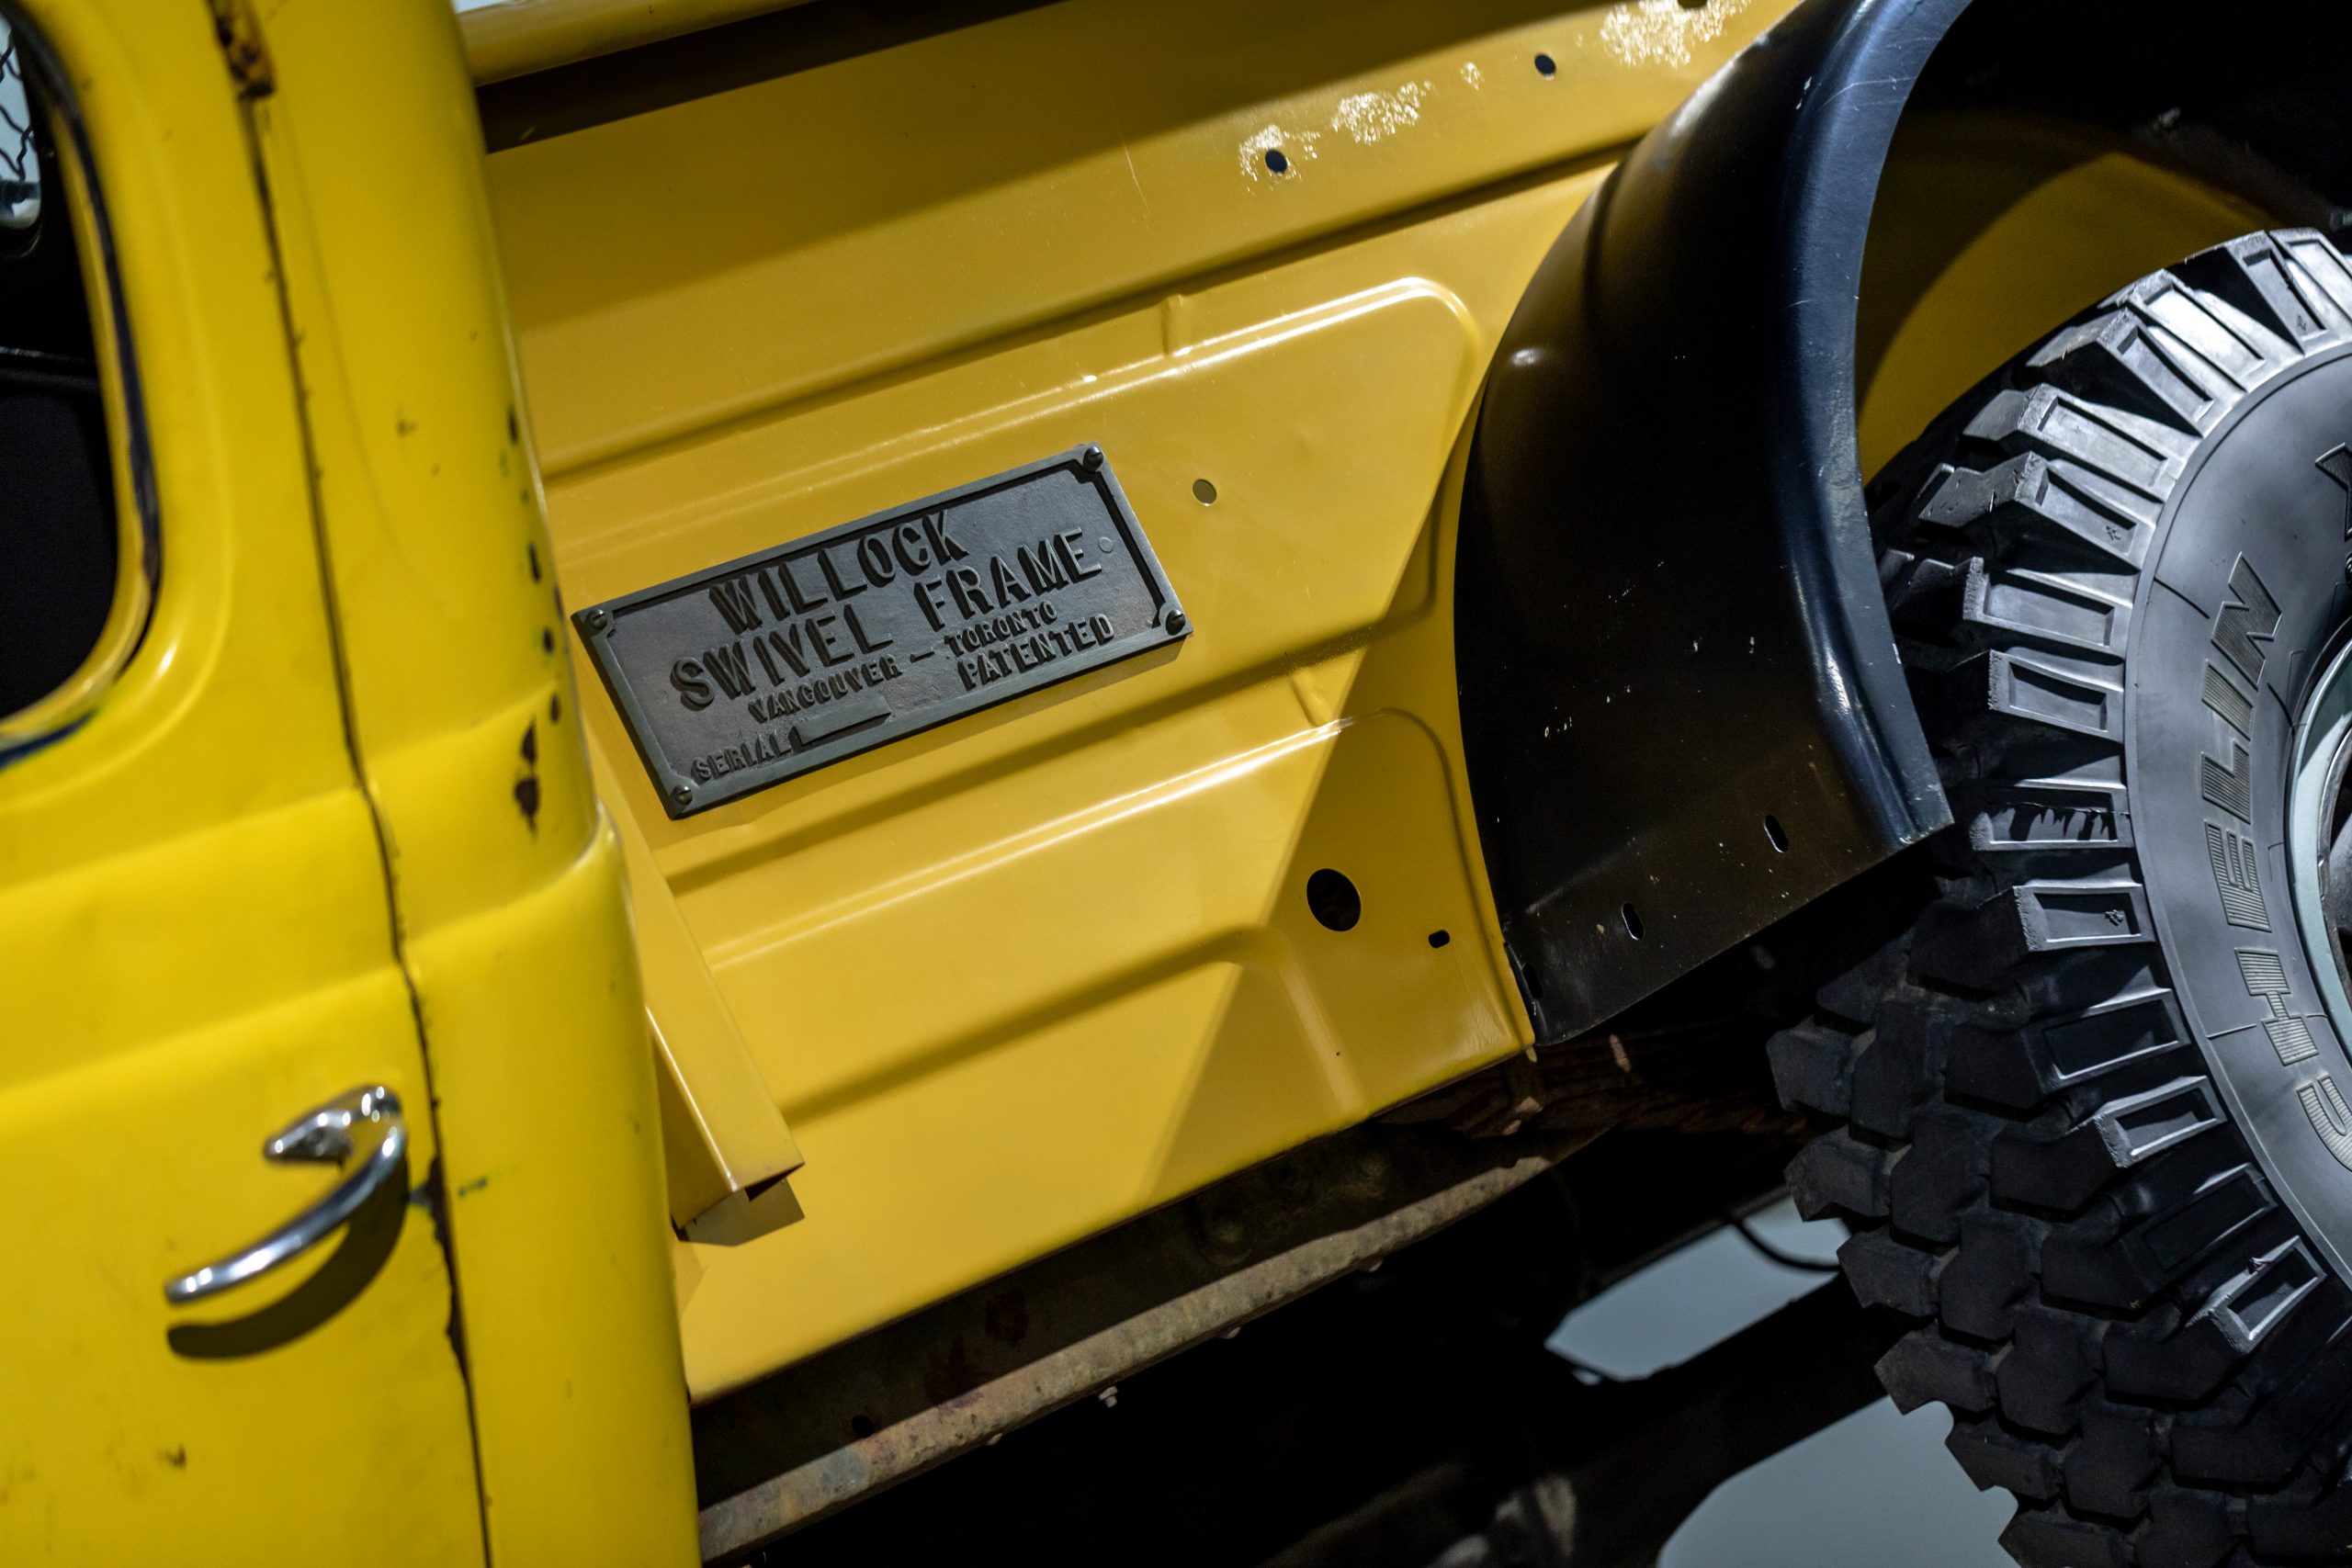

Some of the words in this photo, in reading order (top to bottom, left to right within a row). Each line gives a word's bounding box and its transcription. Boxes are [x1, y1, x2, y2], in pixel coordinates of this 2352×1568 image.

[670, 603, 894, 711] SWIVEL
[913, 526, 1102, 632] FRAME
[708, 509, 969, 636] WILLOCK
[748, 654, 903, 724] VANCOUVER
[944, 600, 1057, 658] TORONTO
[956, 614, 1114, 692] PATENTED
[690, 730, 792, 780] SERIAL
